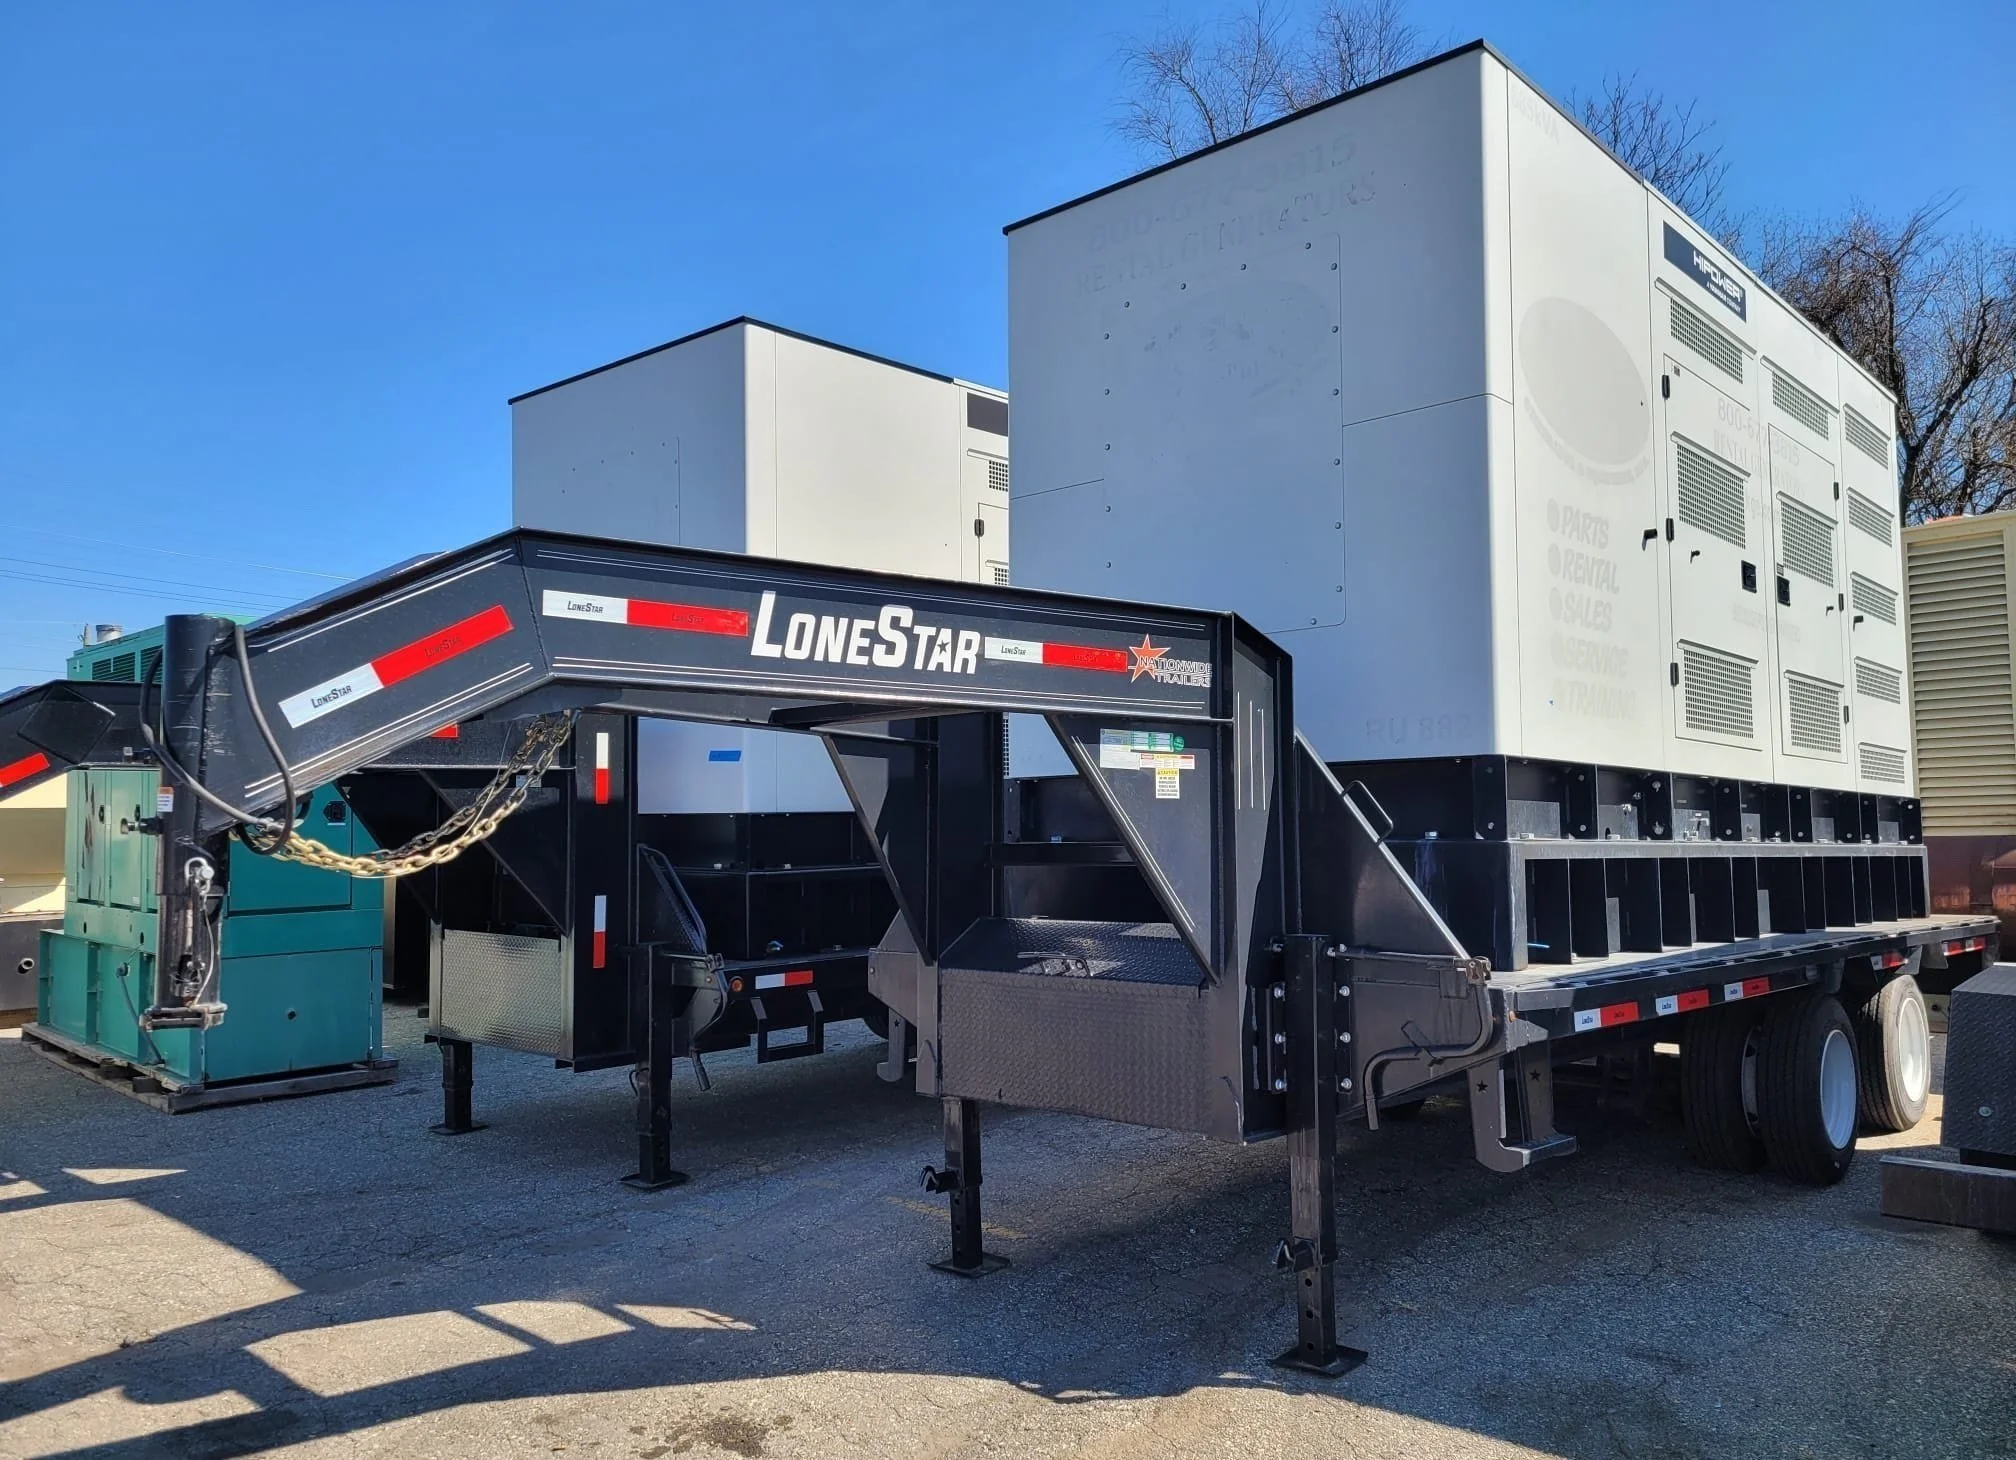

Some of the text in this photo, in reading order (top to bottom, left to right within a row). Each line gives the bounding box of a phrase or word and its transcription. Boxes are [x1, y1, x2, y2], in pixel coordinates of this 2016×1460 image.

[1693, 250, 1741, 303] HIPOWER
[1561, 505, 1609, 550] PARTS
[1562, 548, 1620, 594] RENTAL
[1562, 590, 1612, 632] SALES
[1139, 655, 1212, 675] NATIONWIDE
[1564, 636, 1630, 678] SERVICE
[1157, 673, 1211, 688] TRAILERS
